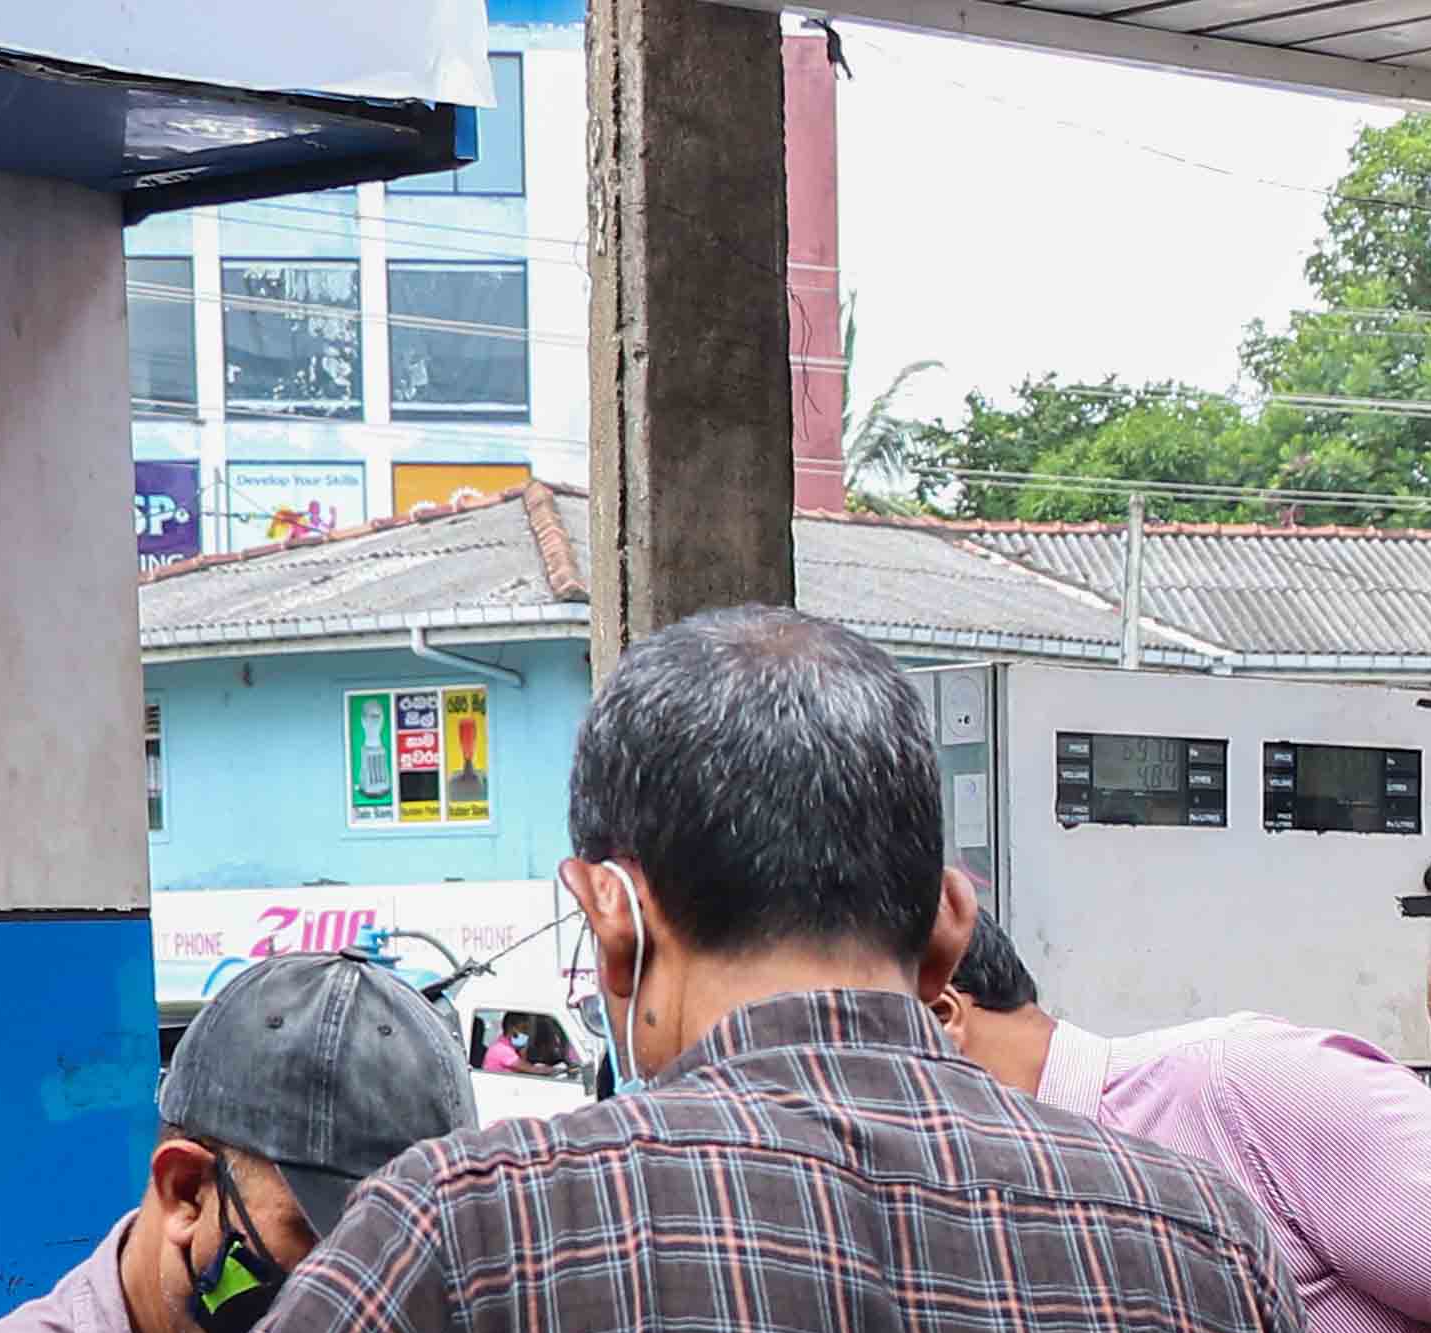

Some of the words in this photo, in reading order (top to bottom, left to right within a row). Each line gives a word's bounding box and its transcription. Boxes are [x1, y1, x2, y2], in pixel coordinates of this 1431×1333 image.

[236, 473, 288, 488] Develop
[292, 474, 321, 487] Your
[325, 473, 359, 487] Skills
[174, 931, 224, 957] PHONE
[462, 924, 516, 945] PHONE
